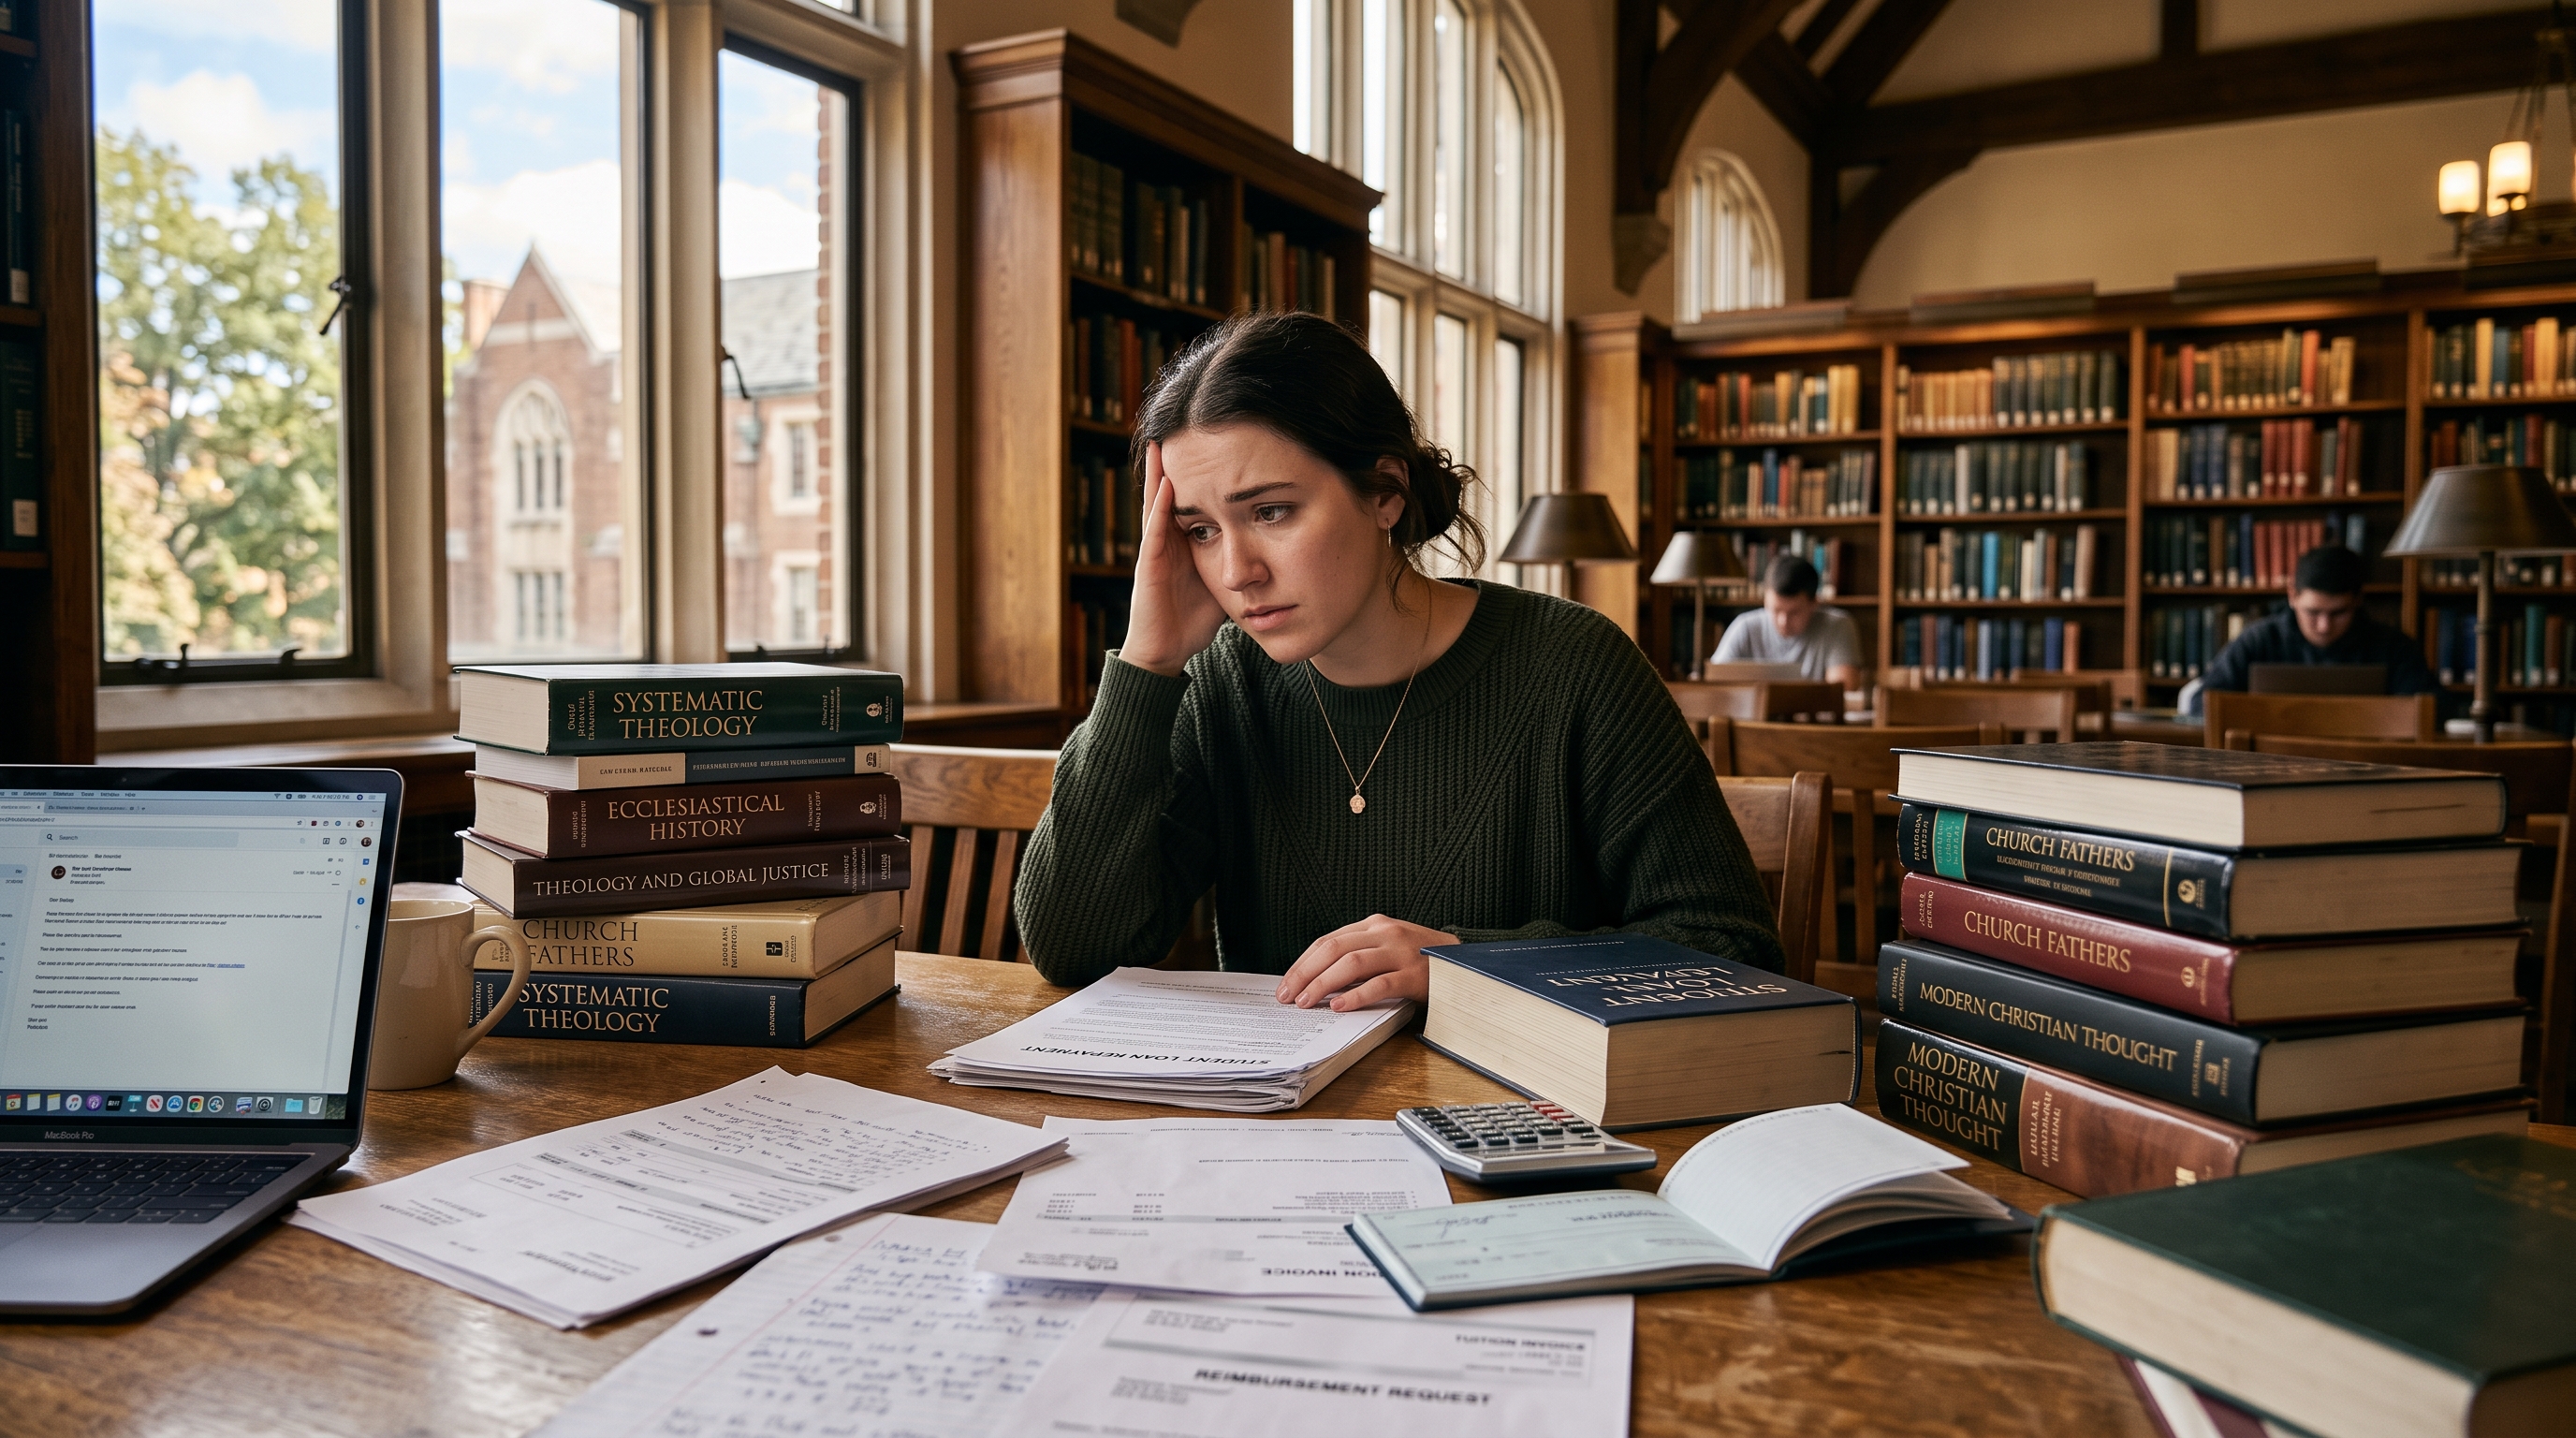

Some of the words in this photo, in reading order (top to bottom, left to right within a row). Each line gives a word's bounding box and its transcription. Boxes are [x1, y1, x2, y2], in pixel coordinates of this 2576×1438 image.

[613, 690, 764, 713] SYSTEMATIC
[619, 715, 758, 740] THEOLOGY
[607, 794, 785, 820] ECCLESIASTICAL
[650, 817, 747, 841] HISTORY
[1985, 827, 2056, 857] CHURCH
[2059, 840, 2136, 872] FATHERS
[533, 875, 637, 896] THEOLOGY
[641, 873, 683, 890] AND
[688, 868, 757, 885] GLOBAL
[761, 863, 829, 885] JUSTICE
[522, 919, 639, 942] CHURCH
[1964, 910, 2042, 950] CHURCH
[2047, 931, 2132, 973] FATHERS
[528, 945, 635, 967] FATHERS
[519, 983, 670, 1008] SYSTEMATIC
[523, 1007, 661, 1033] THEOLOGY
[1920, 982, 1986, 1017] MODERN
[1989, 1002, 2078, 1044] CHRISTIAN
[2082, 1026, 2178, 1072] THOUGHT
[1907, 1041, 2000, 1092] MODERN
[1895, 1065, 2008, 1125] CHRISTIAN
[1900, 1093, 2002, 1152] THOUGHT
[1194, 1368, 1384, 1397] REIMBURSEMENT
[1387, 1386, 1494, 1405] REQUEST
